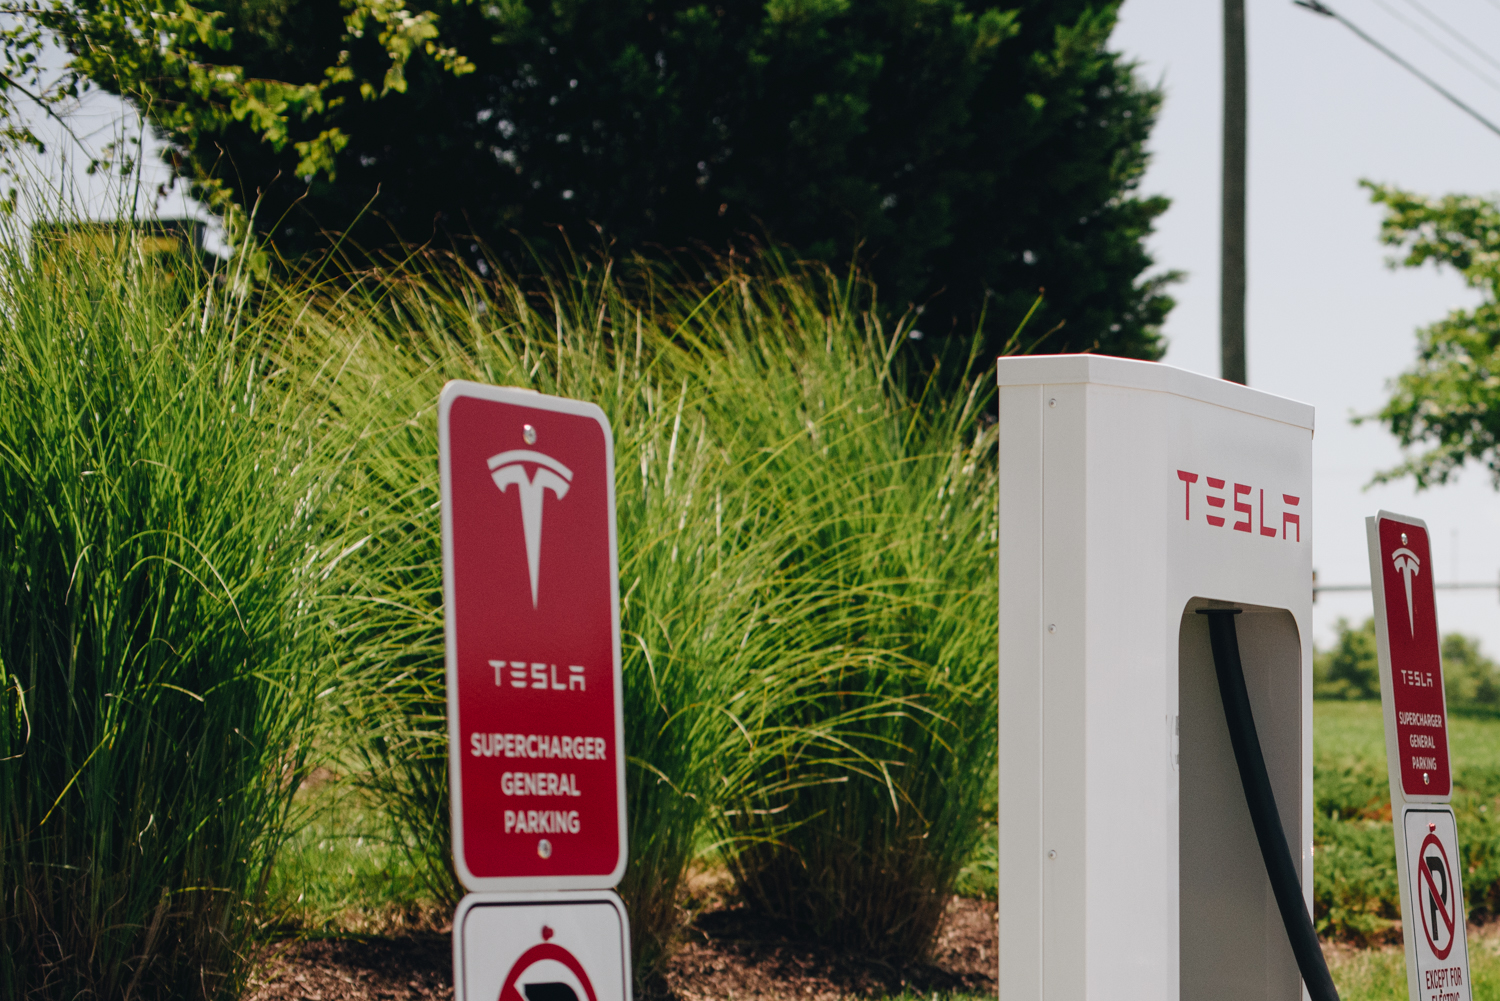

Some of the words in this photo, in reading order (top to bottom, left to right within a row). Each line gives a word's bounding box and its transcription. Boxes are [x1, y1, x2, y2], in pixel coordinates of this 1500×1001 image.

[1177, 469, 1300, 543] TESLA
[488, 660, 586, 692] TESLA
[1401, 669, 1434, 688] TESLA
[1399, 711, 1443, 728] SUPERCHARGER
[470, 732, 607, 761] SUPERCHARGER
[1409, 734, 1436, 749] GENERAL
[1412, 756, 1437, 770] PARKING
[501, 771, 582, 797] GENERAL
[504, 810, 581, 834] PARKING
[1425, 968, 1449, 990] EXCEPT
[1450, 966, 1463, 987] FOR
